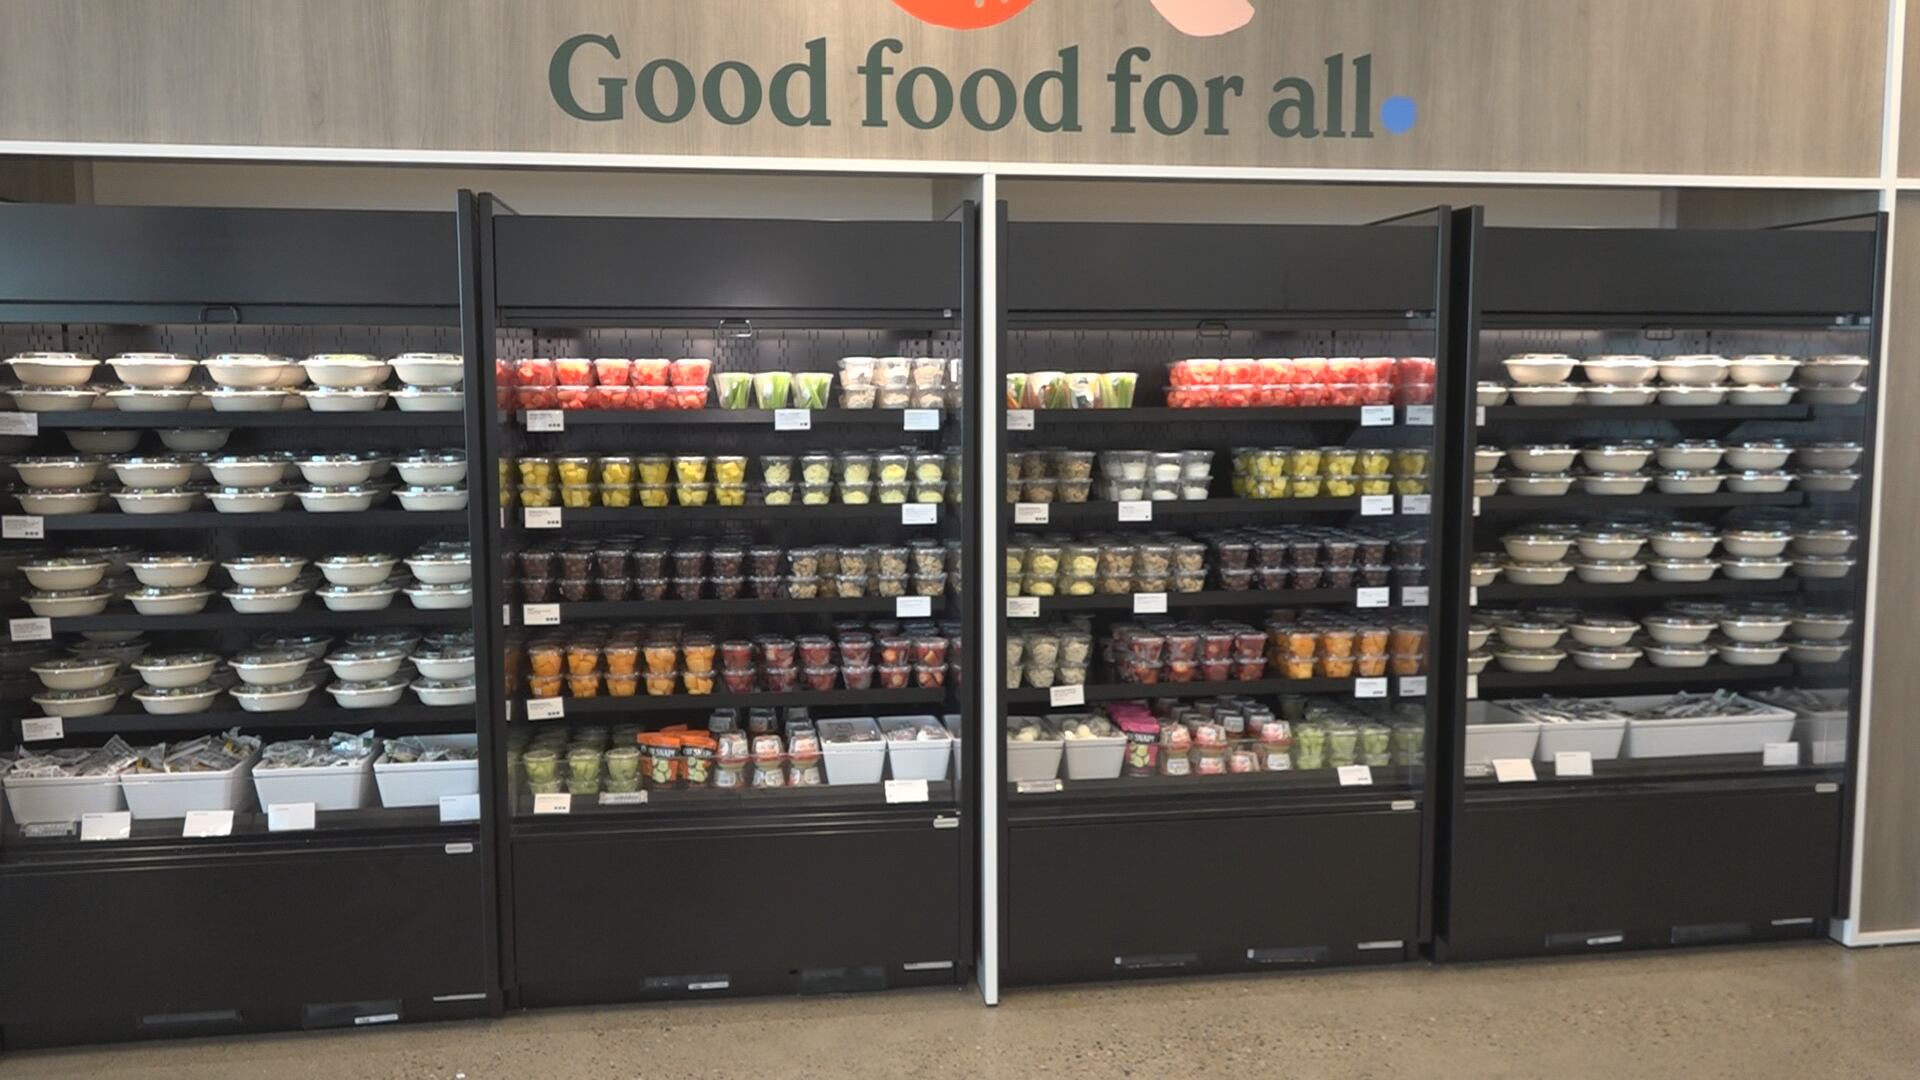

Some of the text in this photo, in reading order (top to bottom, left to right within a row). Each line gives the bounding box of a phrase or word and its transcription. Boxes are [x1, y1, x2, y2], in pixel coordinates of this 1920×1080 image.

[548, 33, 832, 127] Good
[857, 38, 1082, 133] food
[1107, 46, 1244, 136] for
